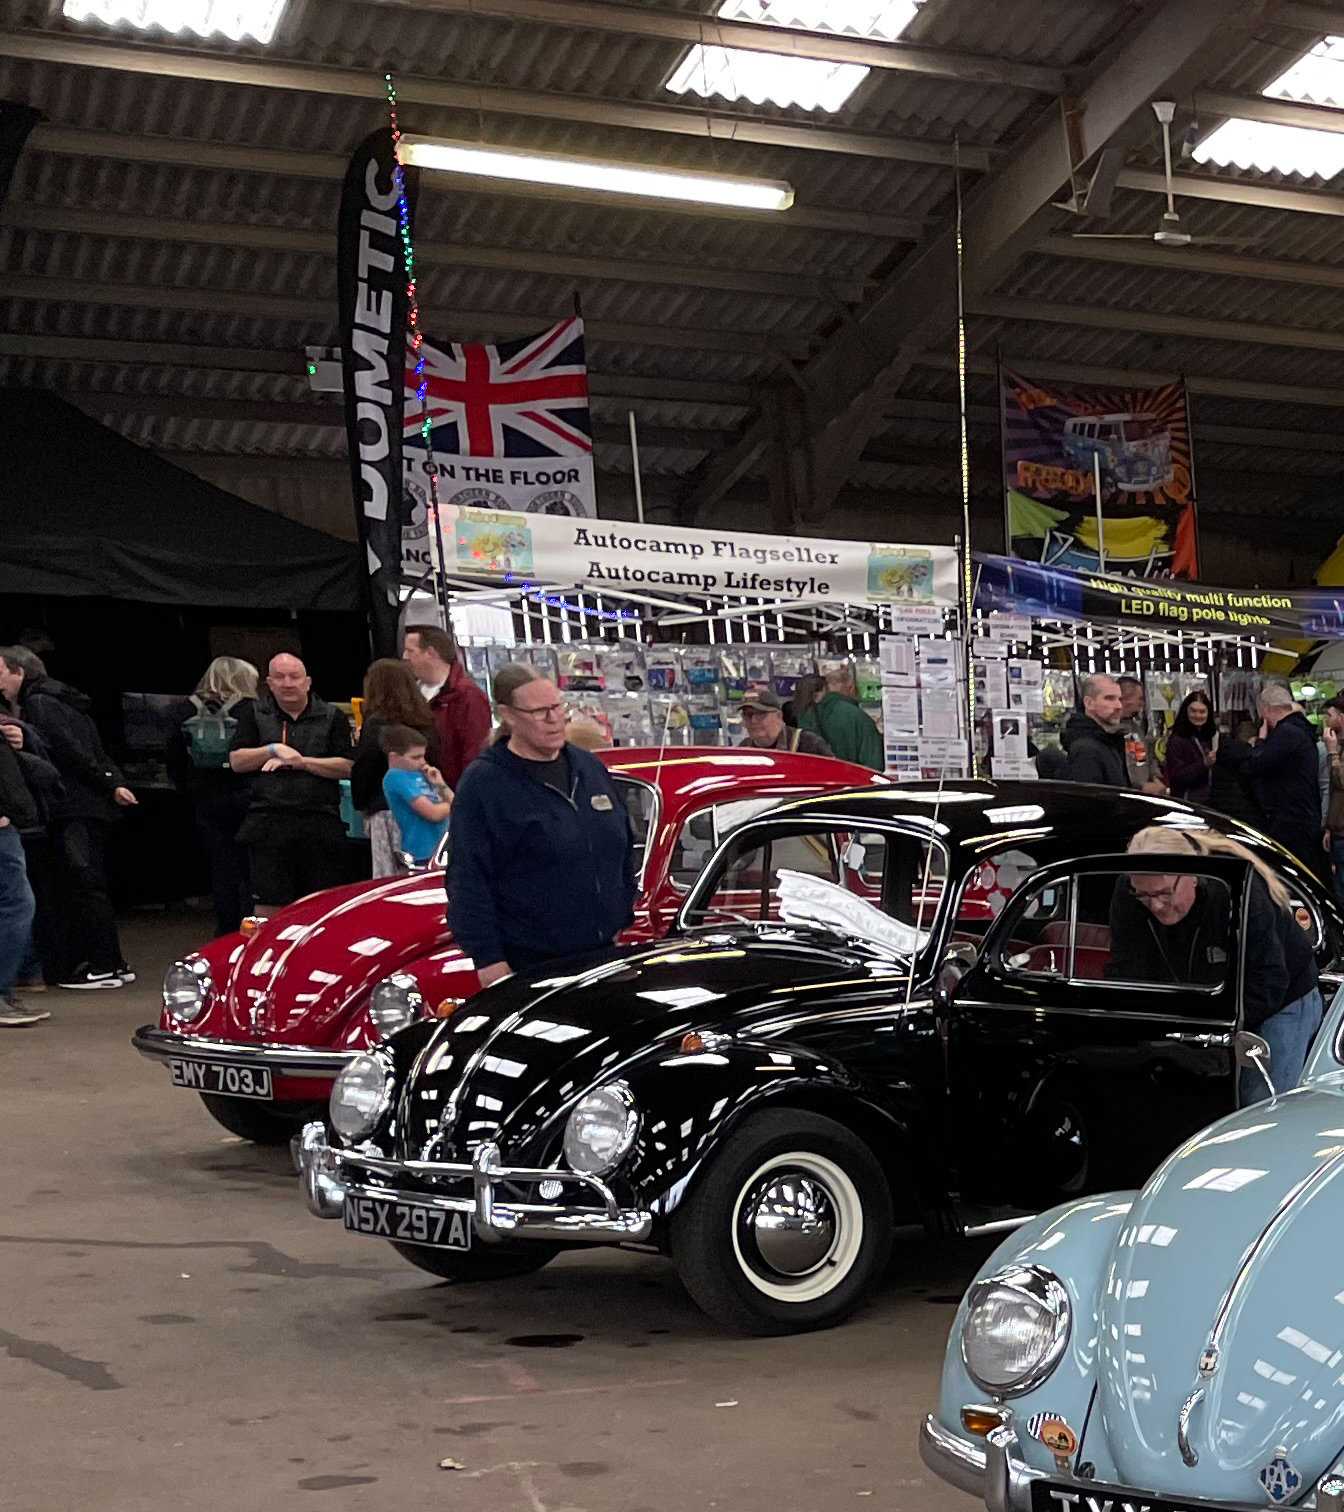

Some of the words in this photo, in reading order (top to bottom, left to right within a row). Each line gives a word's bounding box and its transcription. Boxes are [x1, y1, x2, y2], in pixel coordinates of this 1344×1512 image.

[422, 461, 455, 480] ON
[461, 465, 504, 484] THE
[510, 468, 580, 486] FLOOR
[573, 528, 704, 558] Autocamp
[711, 540, 839, 567] Flagseller
[586, 561, 717, 590] Autocamp
[724, 570, 830, 598] Lifestyle
[1089, 578, 1128, 594] High
[1131, 586, 1182, 601] quality
[1186, 592, 1224, 606] multi
[1227, 593, 1292, 608] function
[1121, 599, 1154, 615] LED
[1159, 602, 1188, 622] flag
[1192, 607, 1226, 622] pole
[1228, 610, 1271, 626] lights
[171, 1060, 206, 1088] EMY
[211, 1065, 269, 1095] 703J
[346, 1199, 390, 1234] NSX
[1265, 1461, 1299, 1496] RAC
